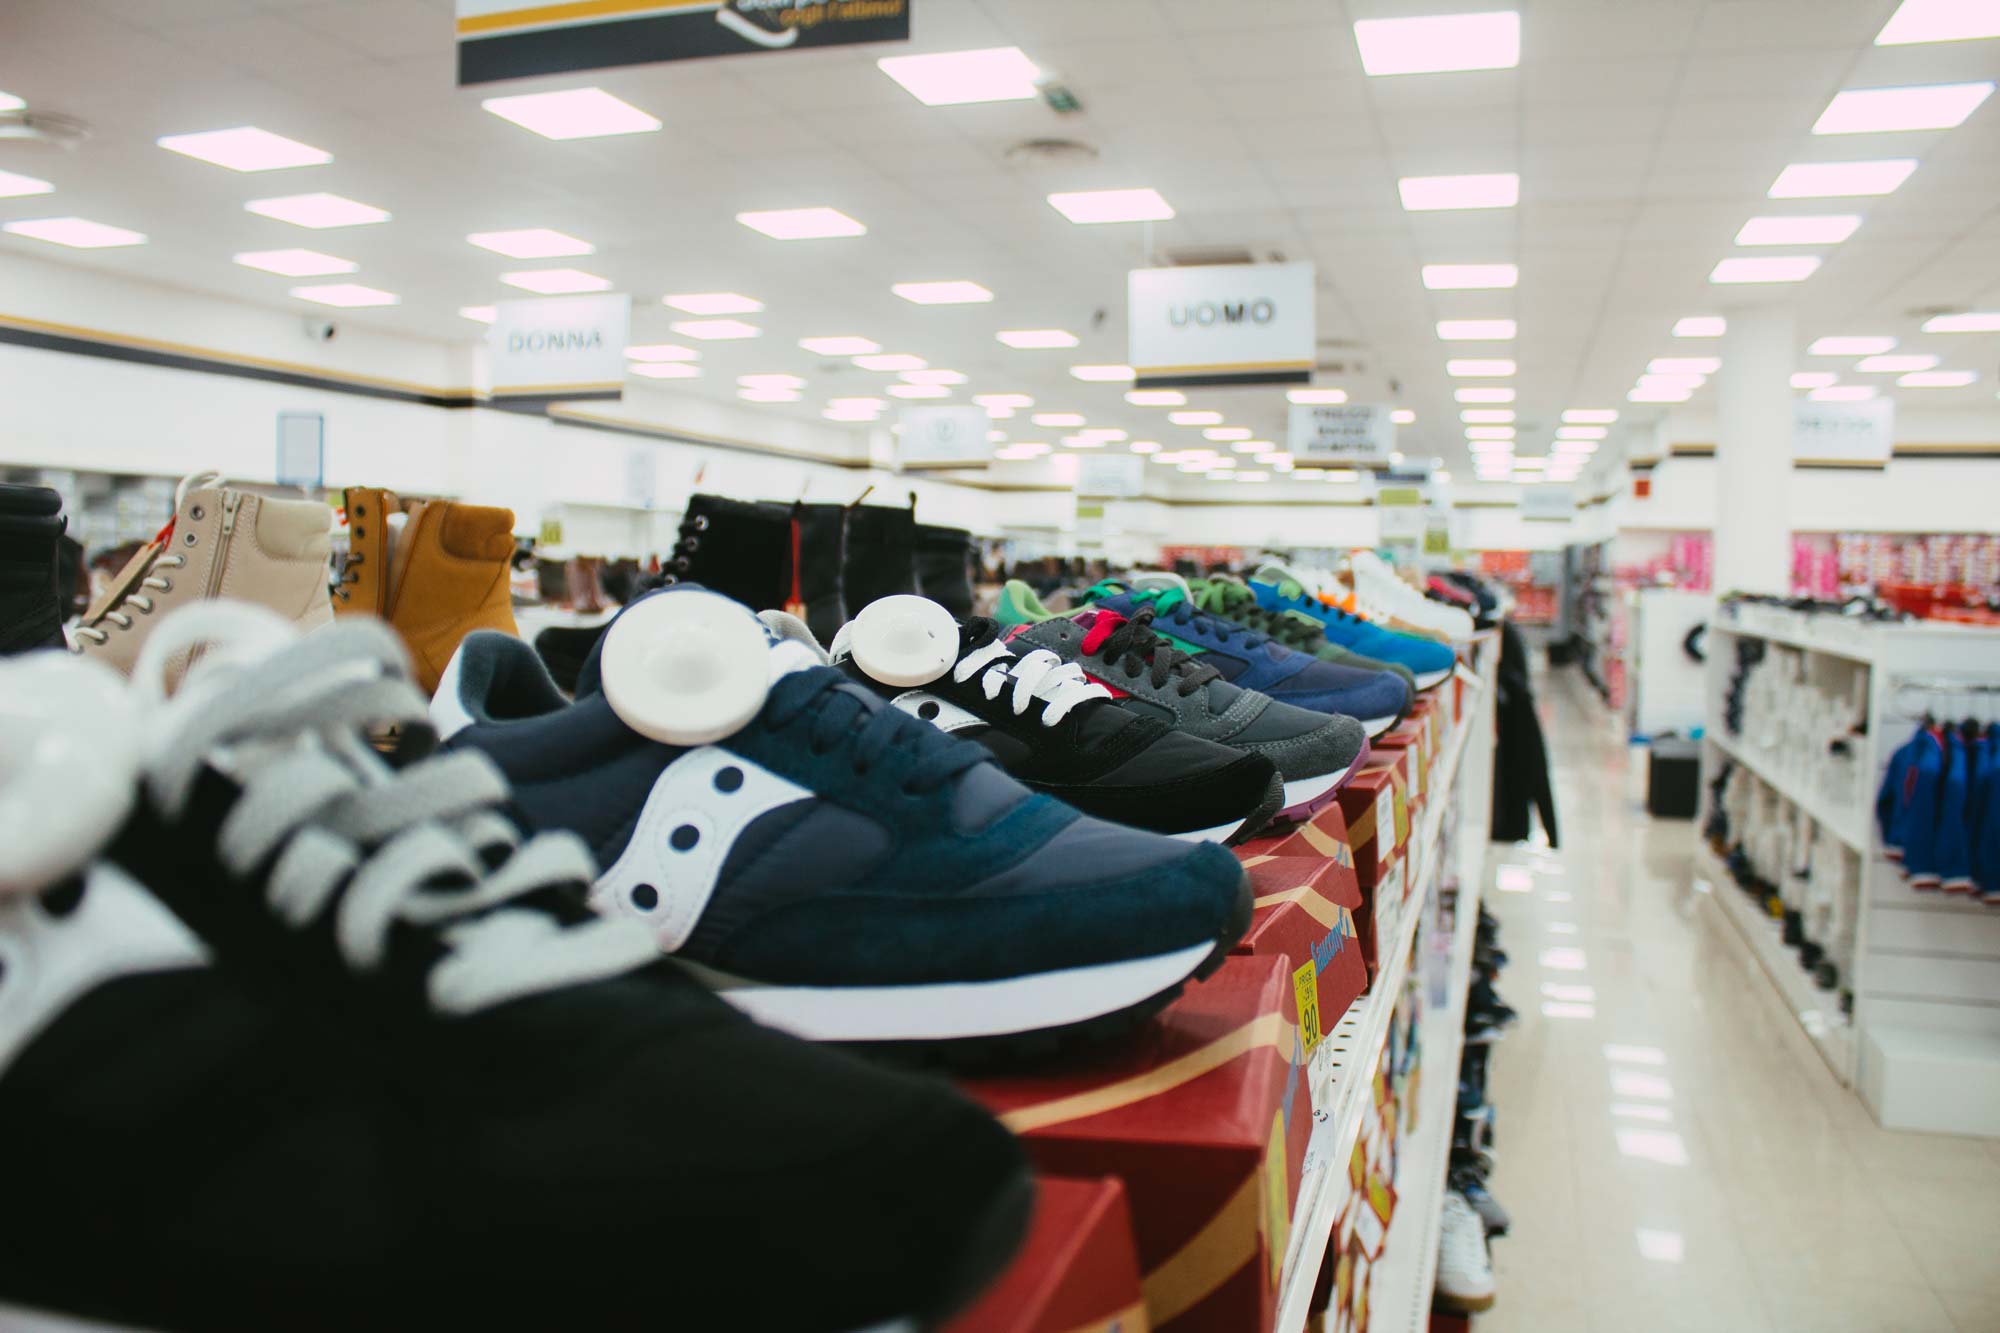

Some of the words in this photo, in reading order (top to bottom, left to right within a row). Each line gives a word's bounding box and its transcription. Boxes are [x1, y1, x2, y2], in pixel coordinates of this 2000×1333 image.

[1169, 297, 1276, 327] UOMO
[508, 329, 603, 352] DONNA
[1303, 1003, 1318, 1046] 90
